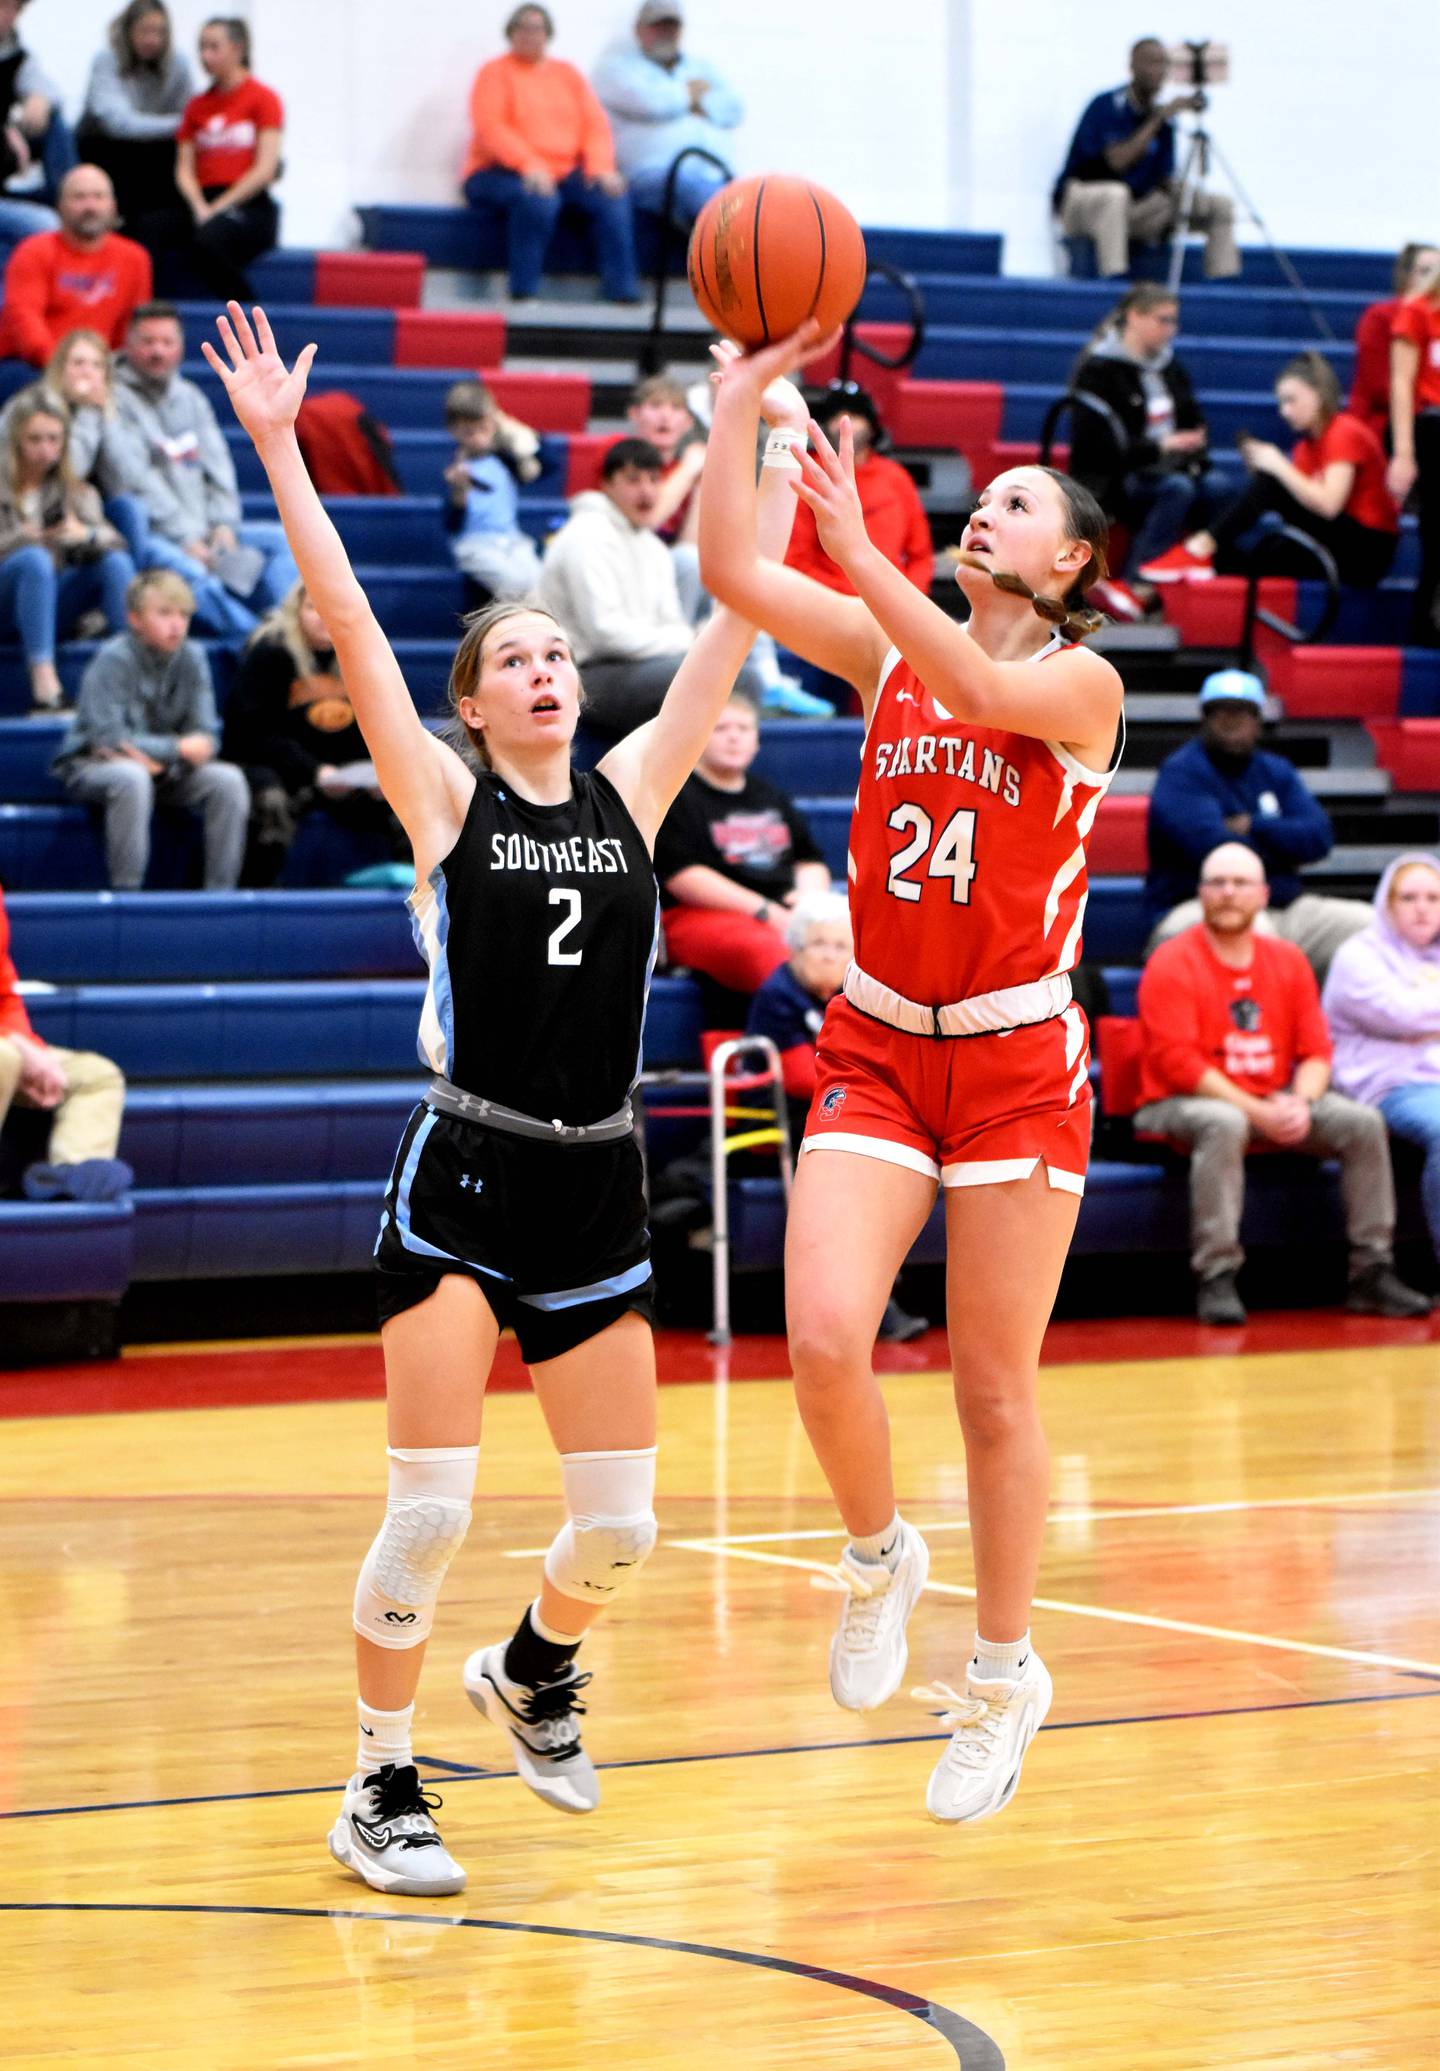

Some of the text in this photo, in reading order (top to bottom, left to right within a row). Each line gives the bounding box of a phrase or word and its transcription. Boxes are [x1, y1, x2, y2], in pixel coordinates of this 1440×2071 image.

[490, 833, 628, 873] SOUTHEAST
[886, 801, 978, 906] 24
[548, 887, 583, 966] 2
